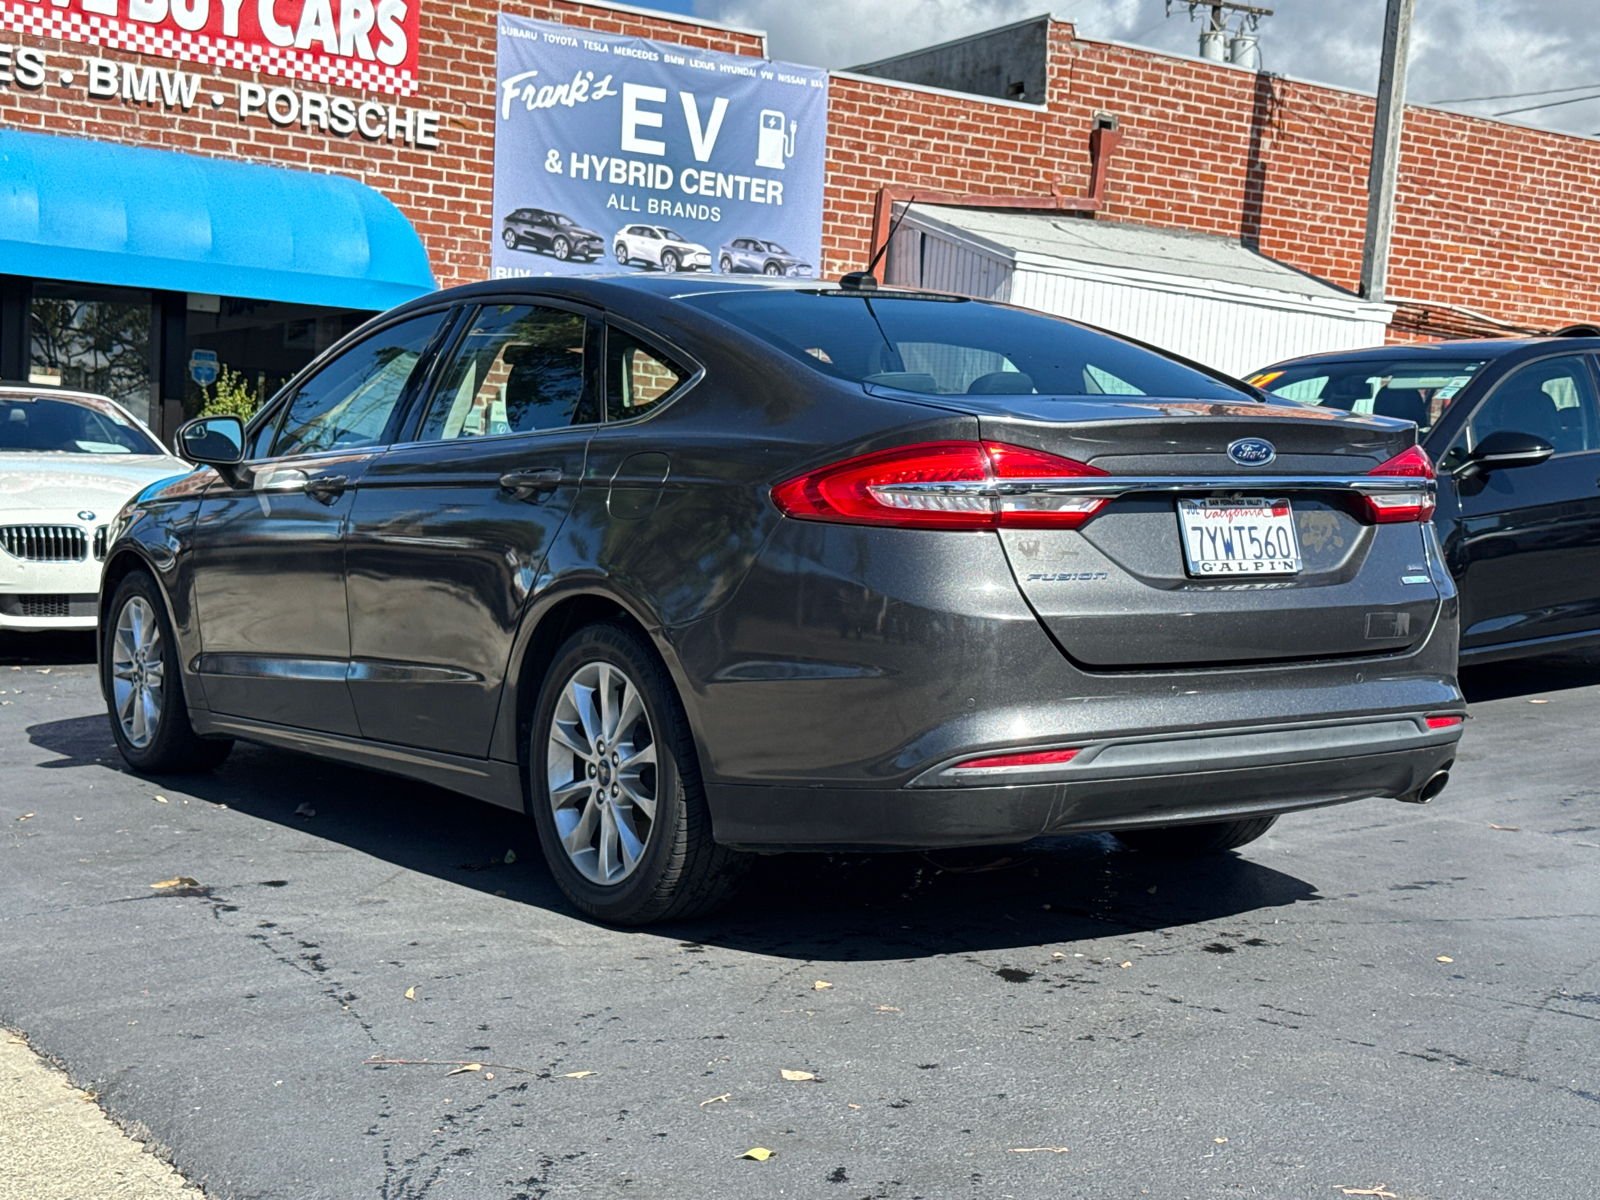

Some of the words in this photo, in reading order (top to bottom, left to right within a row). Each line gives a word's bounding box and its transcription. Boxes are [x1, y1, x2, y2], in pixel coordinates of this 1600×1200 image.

[257, 0, 408, 66] CARS
[500, 25, 538, 41] SUBARU
[543, 33, 578, 48] TOYOTA
[583, 40, 609, 53] TESLA
[613, 46, 659, 62] MERCEDES
[664, 54, 685, 66] BMW
[689, 59, 715, 71] LEXUS
[720, 64, 757, 77] HYUNDAI
[760, 71, 774, 81] VW
[778, 74, 807, 86] NISSAN
[88, 57, 201, 108] BMW
[239, 81, 441, 147] PORSCHE
[501, 70, 618, 120] Frank's
[621, 82, 730, 163] EV
[544, 149, 563, 174] &
[570, 152, 674, 190] HYBRID
[680, 168, 784, 206] CENTER
[606, 193, 641, 212] ALL
[647, 198, 721, 222] BRANDS
[1186, 504, 1200, 515] JUL
[1204, 508, 1272, 524] California
[1208, 499, 1219, 507] SAN
[1220, 499, 1245, 507] FERNANDO
[1191, 525, 1291, 560] 7YWT560
[1026, 572, 1108, 581] FUSION
